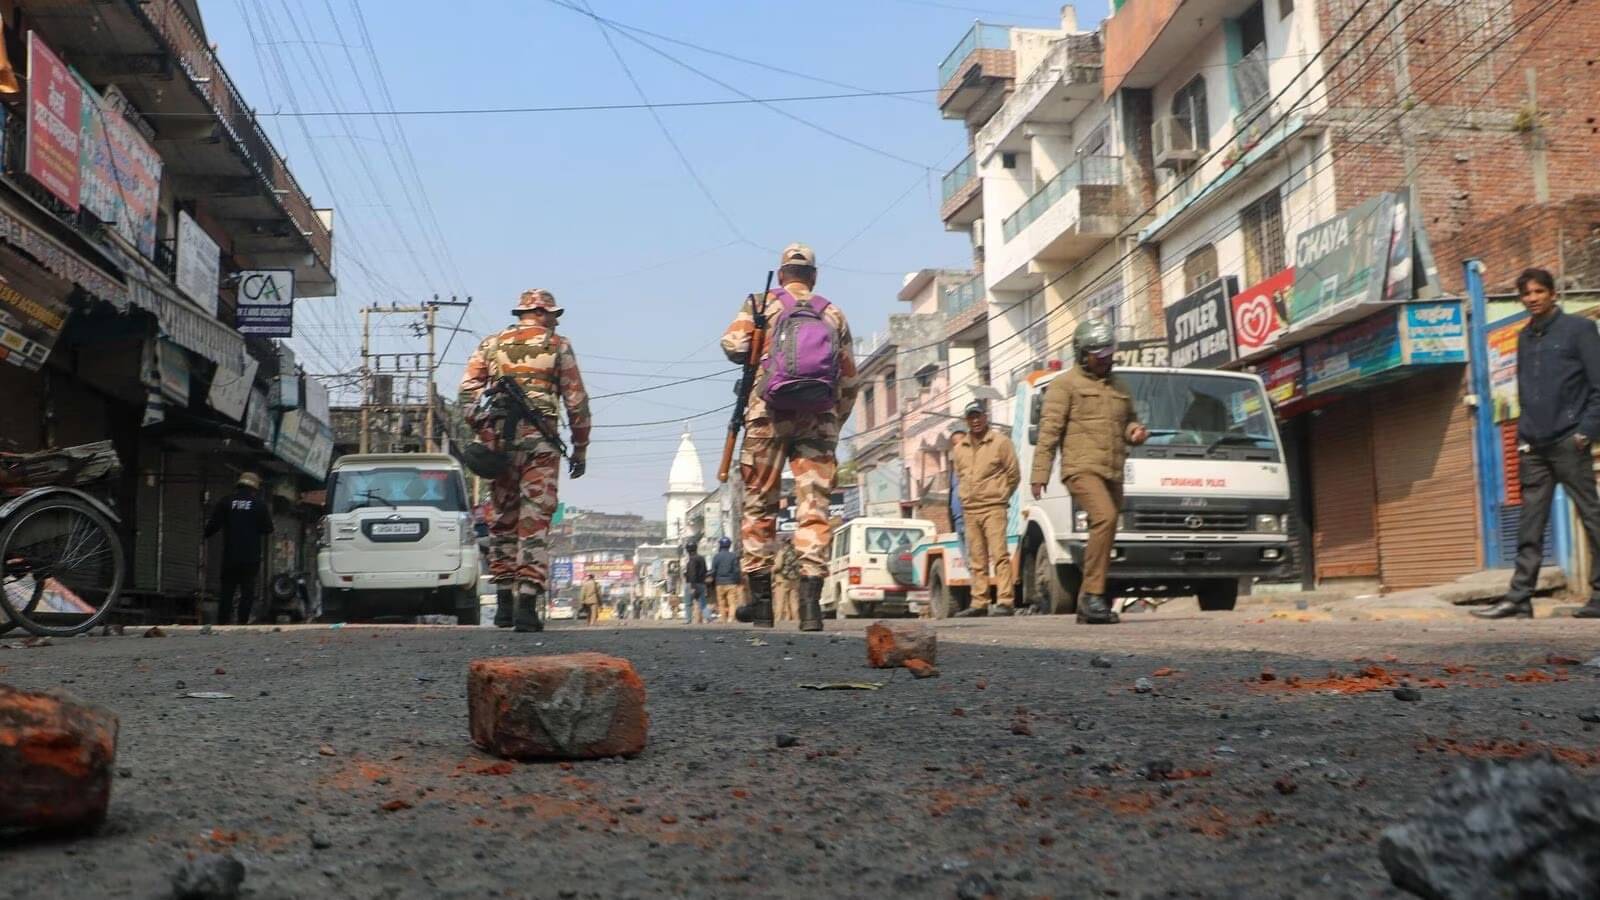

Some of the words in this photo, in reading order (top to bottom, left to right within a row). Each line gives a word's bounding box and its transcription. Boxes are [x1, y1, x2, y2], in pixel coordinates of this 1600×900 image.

[1297, 217, 1348, 268] OKAYA
[243, 274, 281, 301] CA
[1175, 299, 1218, 343] STYLER
[232, 500, 252, 510] FIRE
